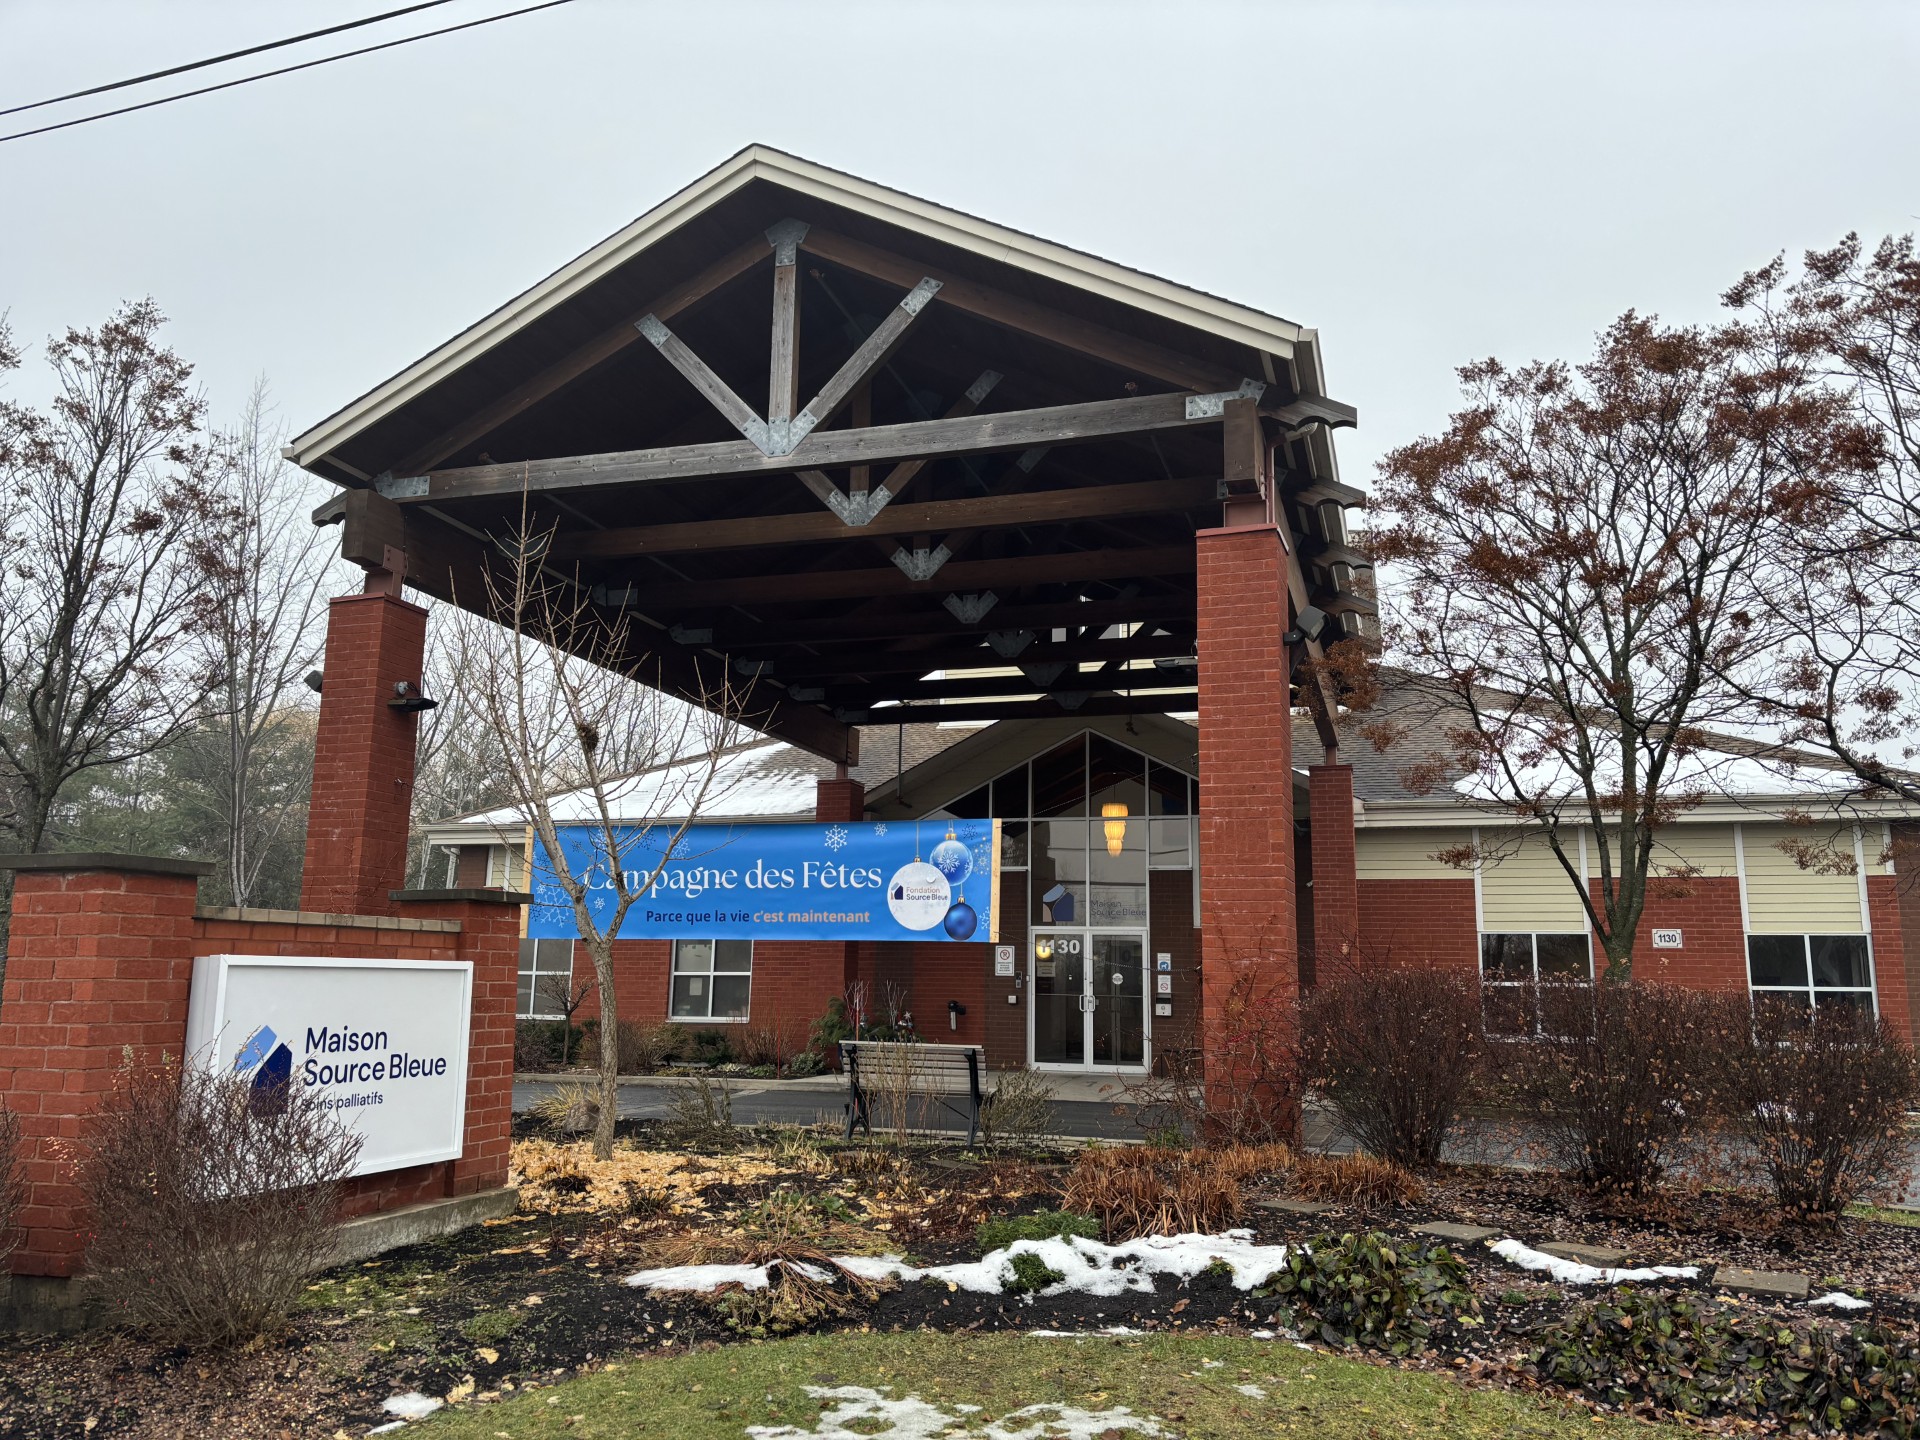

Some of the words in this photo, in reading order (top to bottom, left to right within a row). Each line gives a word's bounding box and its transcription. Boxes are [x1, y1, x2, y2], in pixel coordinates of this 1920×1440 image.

[582, 862, 738, 899] Campagne
[744, 858, 795, 889] des
[802, 860, 882, 889] Fêtes
[906, 886, 941, 894] Fondation
[646, 910, 683, 922] Parce
[686, 913, 711, 926] que
[714, 910, 726, 922] la
[730, 910, 750, 922] vie
[788, 910, 870, 923] maintenant
[1040, 939, 1080, 954] 1130
[1658, 934, 1676, 943] 1130
[305, 1025, 388, 1054] Maison
[303, 1059, 385, 1087] Source
[389, 1053, 447, 1079] Bleue
[336, 1091, 383, 1110] palliatifs
